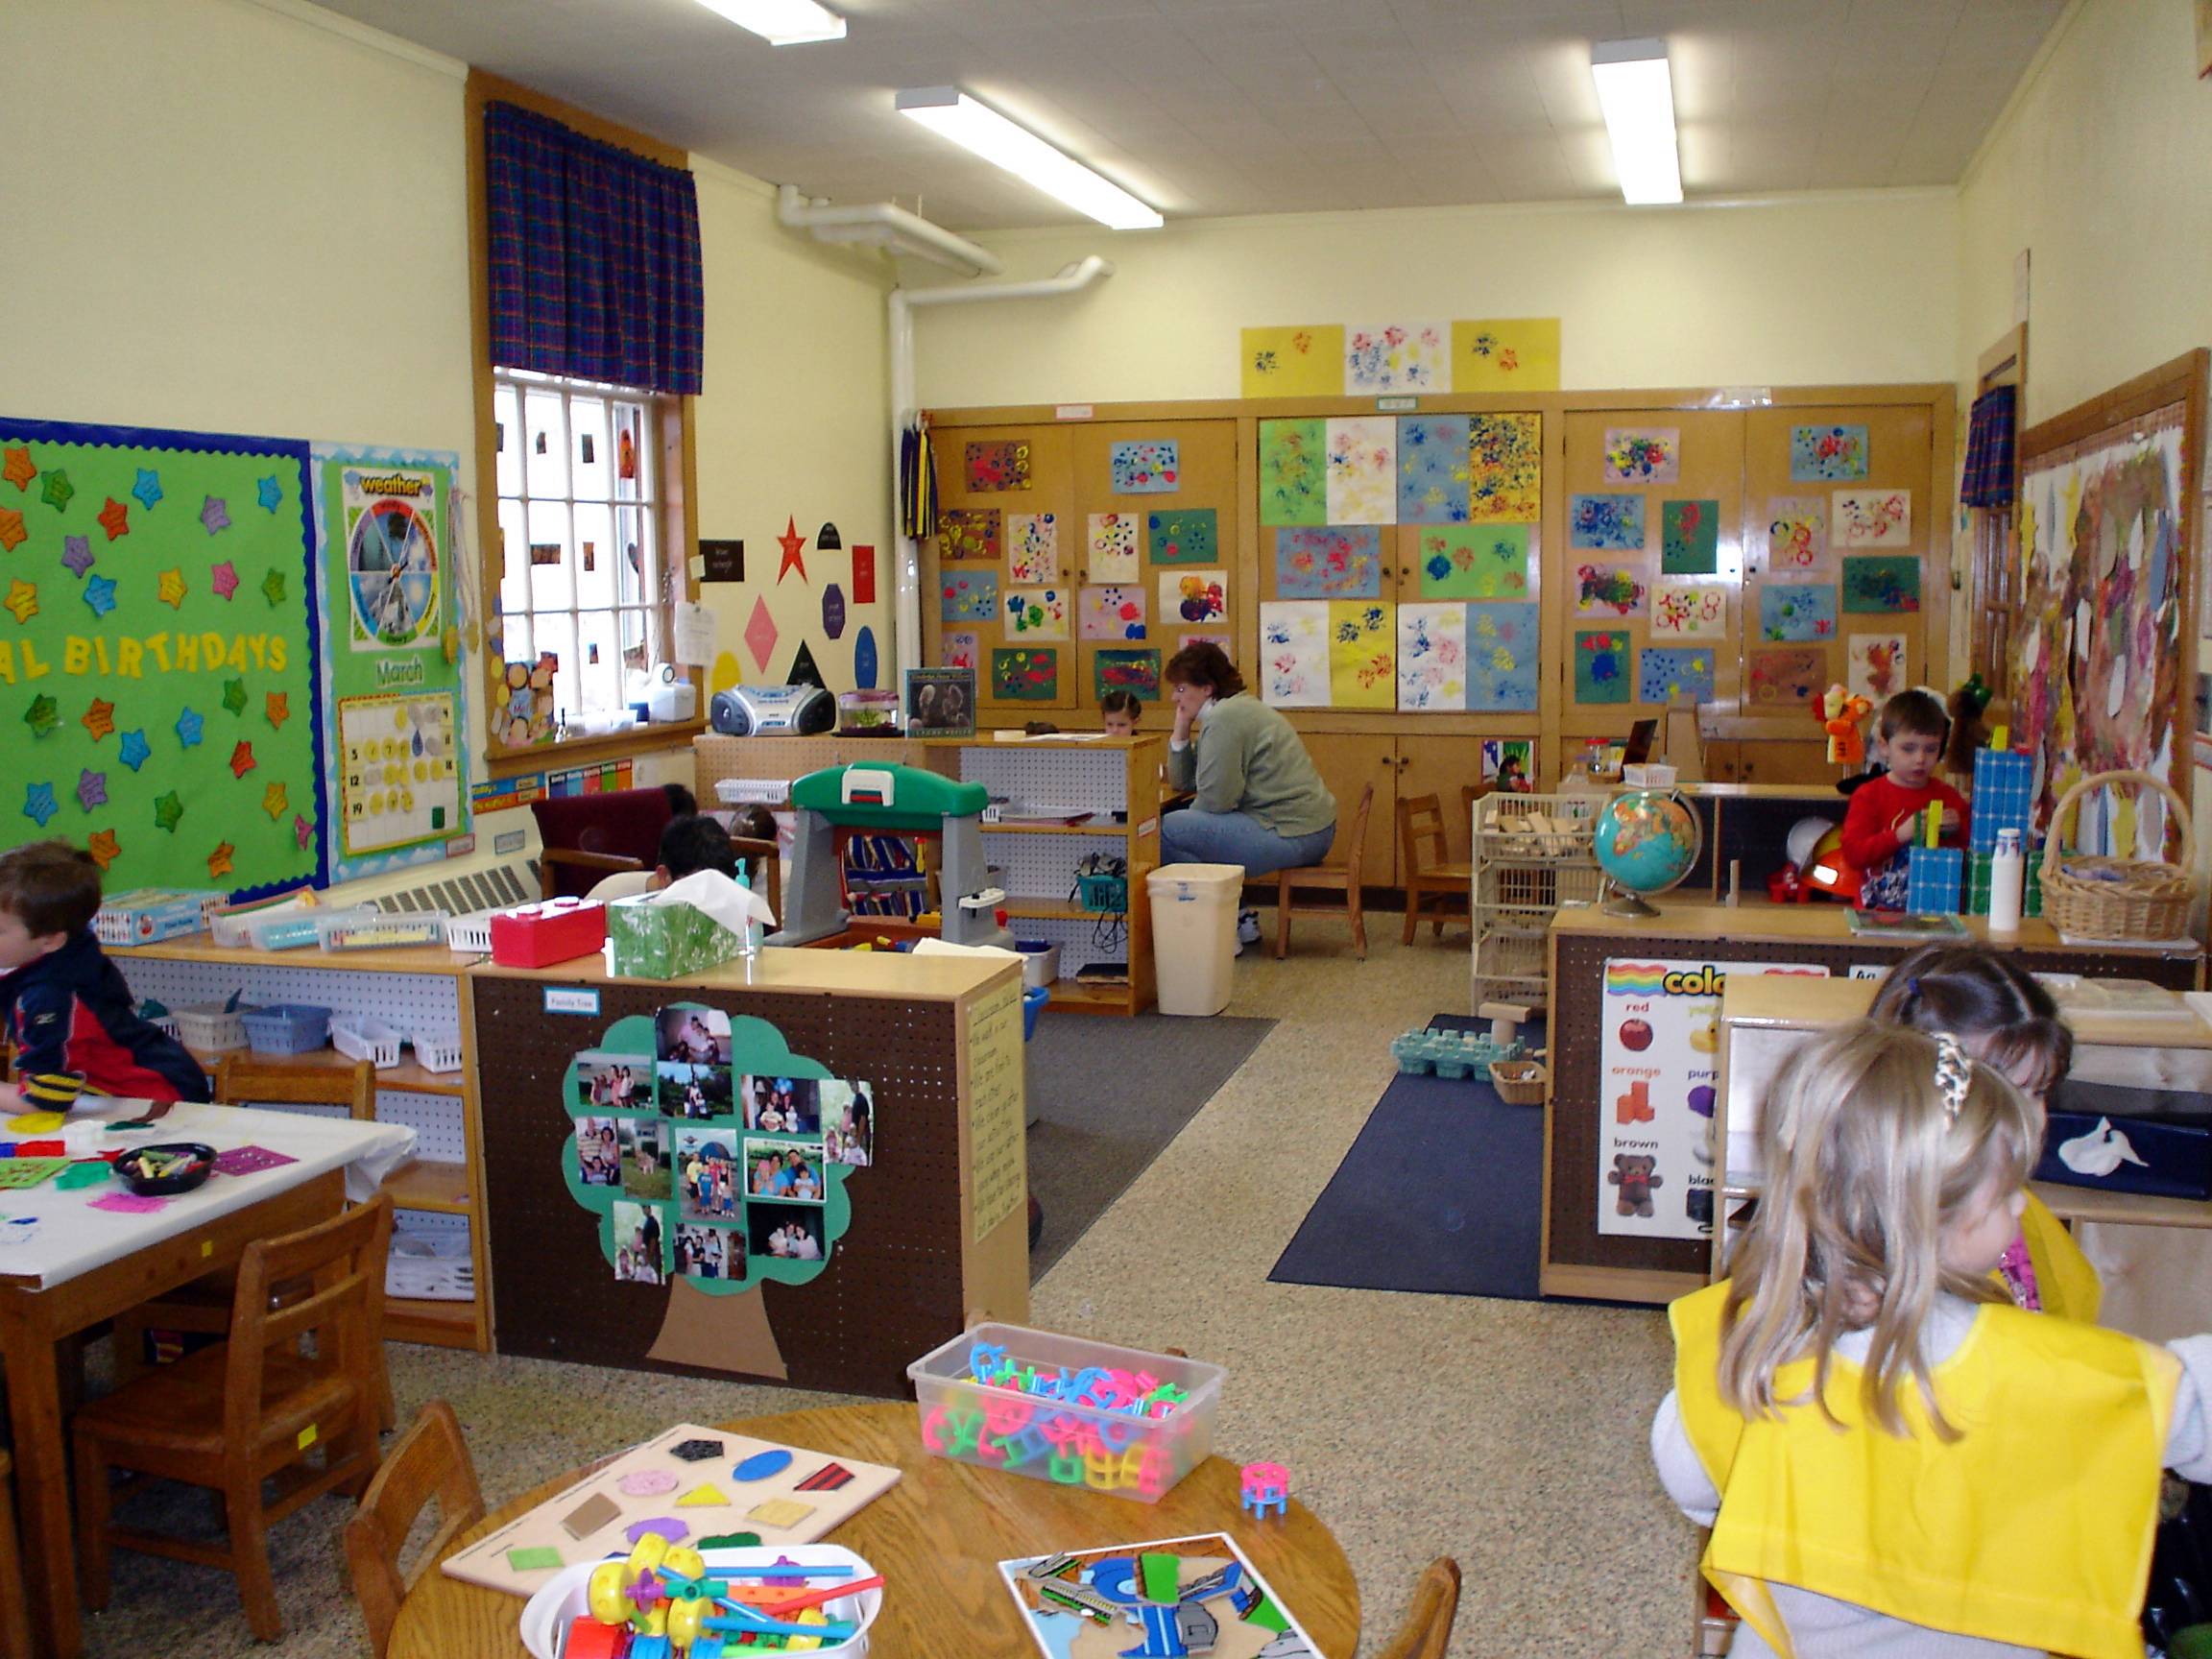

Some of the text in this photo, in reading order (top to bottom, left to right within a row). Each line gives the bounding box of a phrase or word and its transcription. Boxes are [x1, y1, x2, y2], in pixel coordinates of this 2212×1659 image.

[360, 473, 423, 497] weather
[64, 632, 287, 679] BIRTHDAYS
[377, 659, 423, 685] March
[1625, 1001, 1650, 1013] red
[1611, 1065, 1661, 1079] orange
[1614, 1137, 1659, 1149] brown
